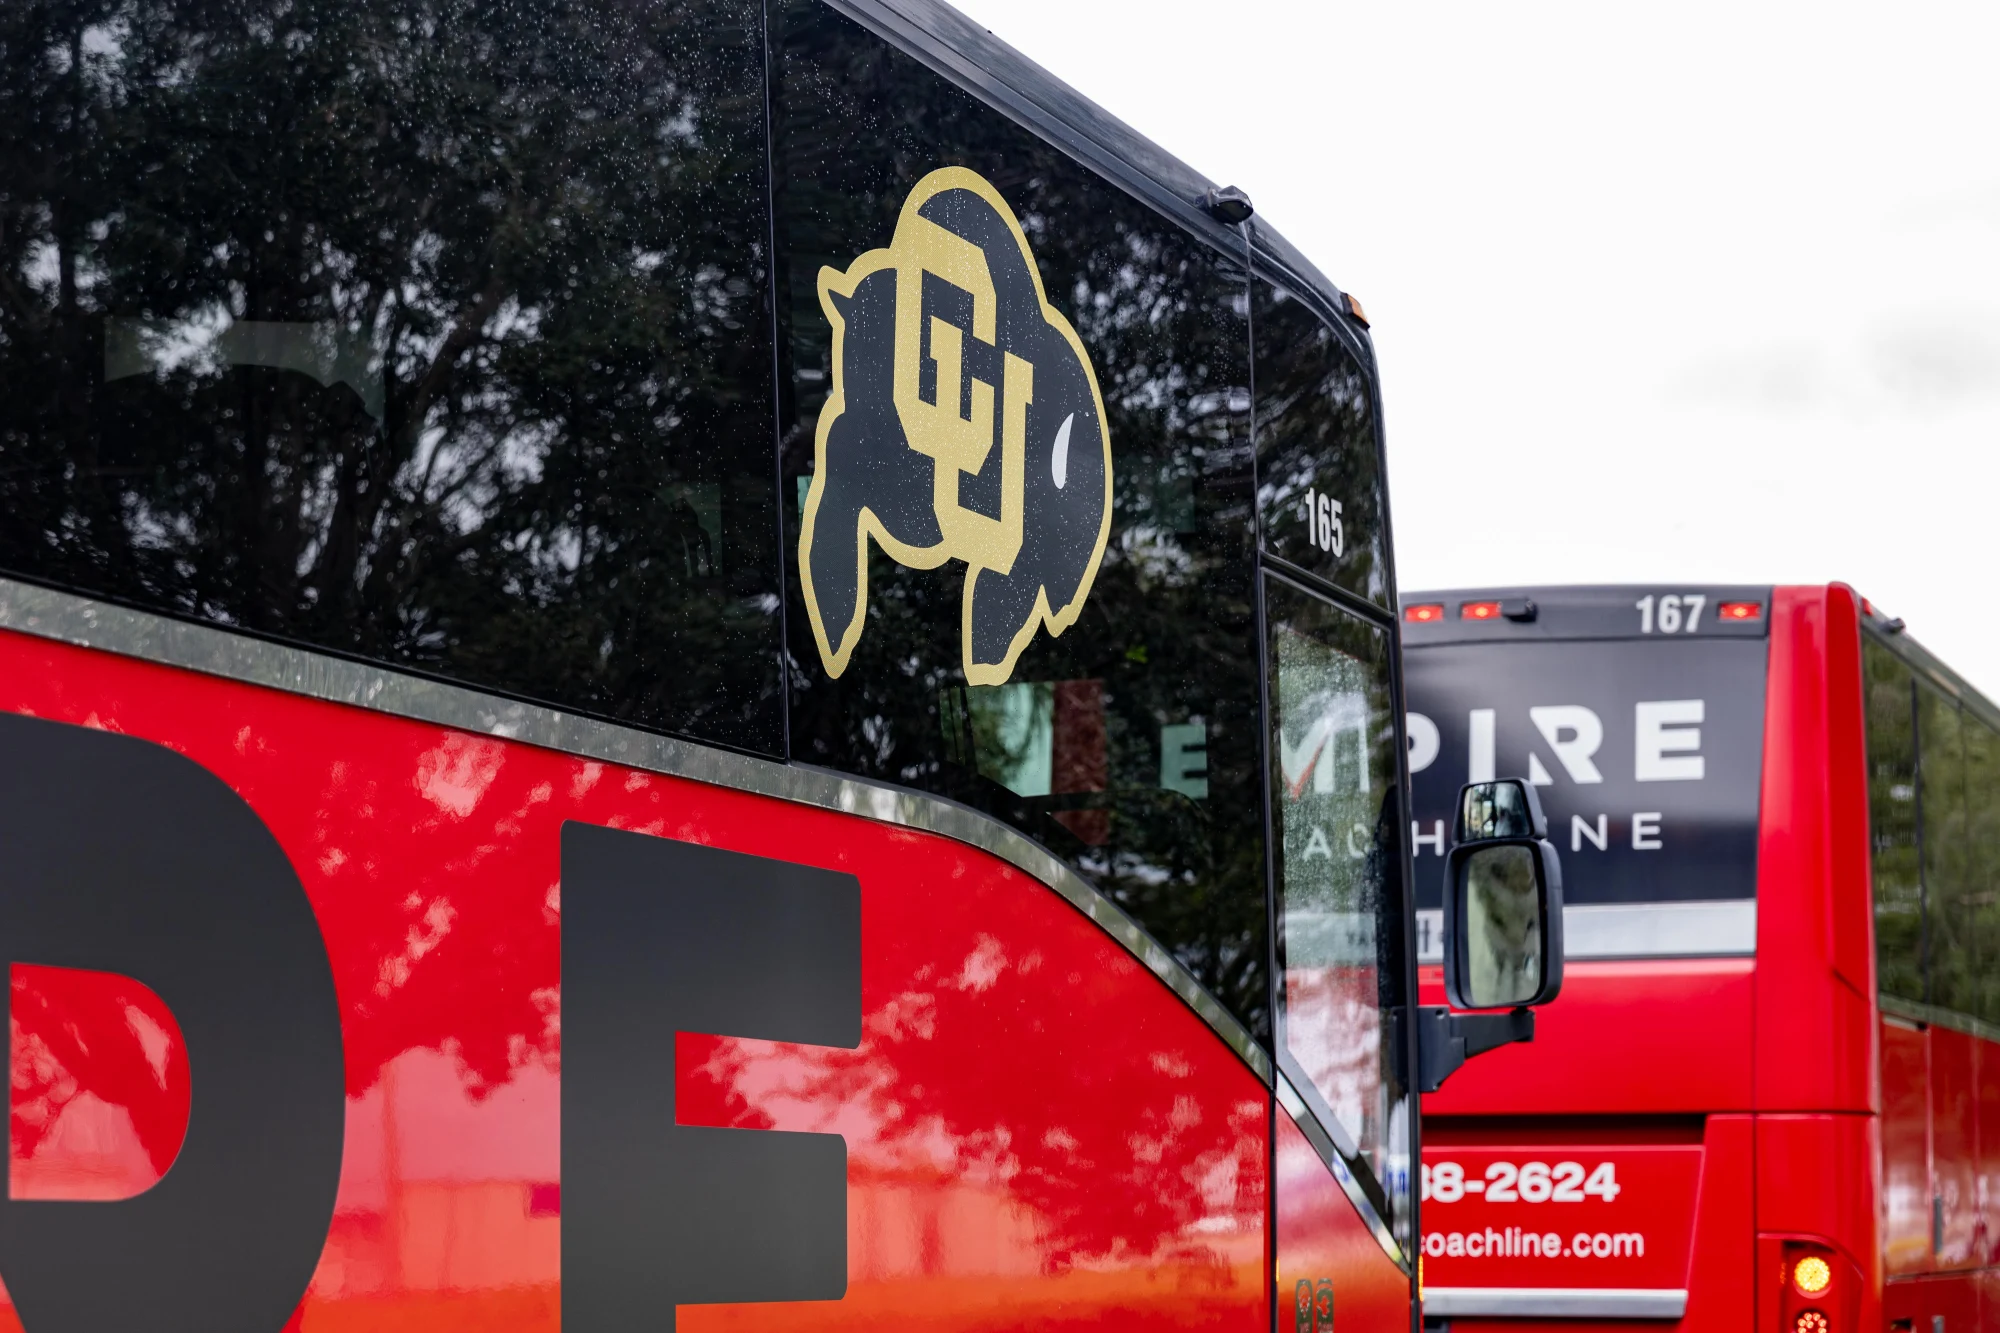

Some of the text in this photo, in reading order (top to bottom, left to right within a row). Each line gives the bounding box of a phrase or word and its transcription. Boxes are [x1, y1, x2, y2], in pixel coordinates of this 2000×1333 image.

[893, 205, 1034, 577] CU
[1305, 487, 1344, 558] 165
[1636, 594, 1706, 634] 167
